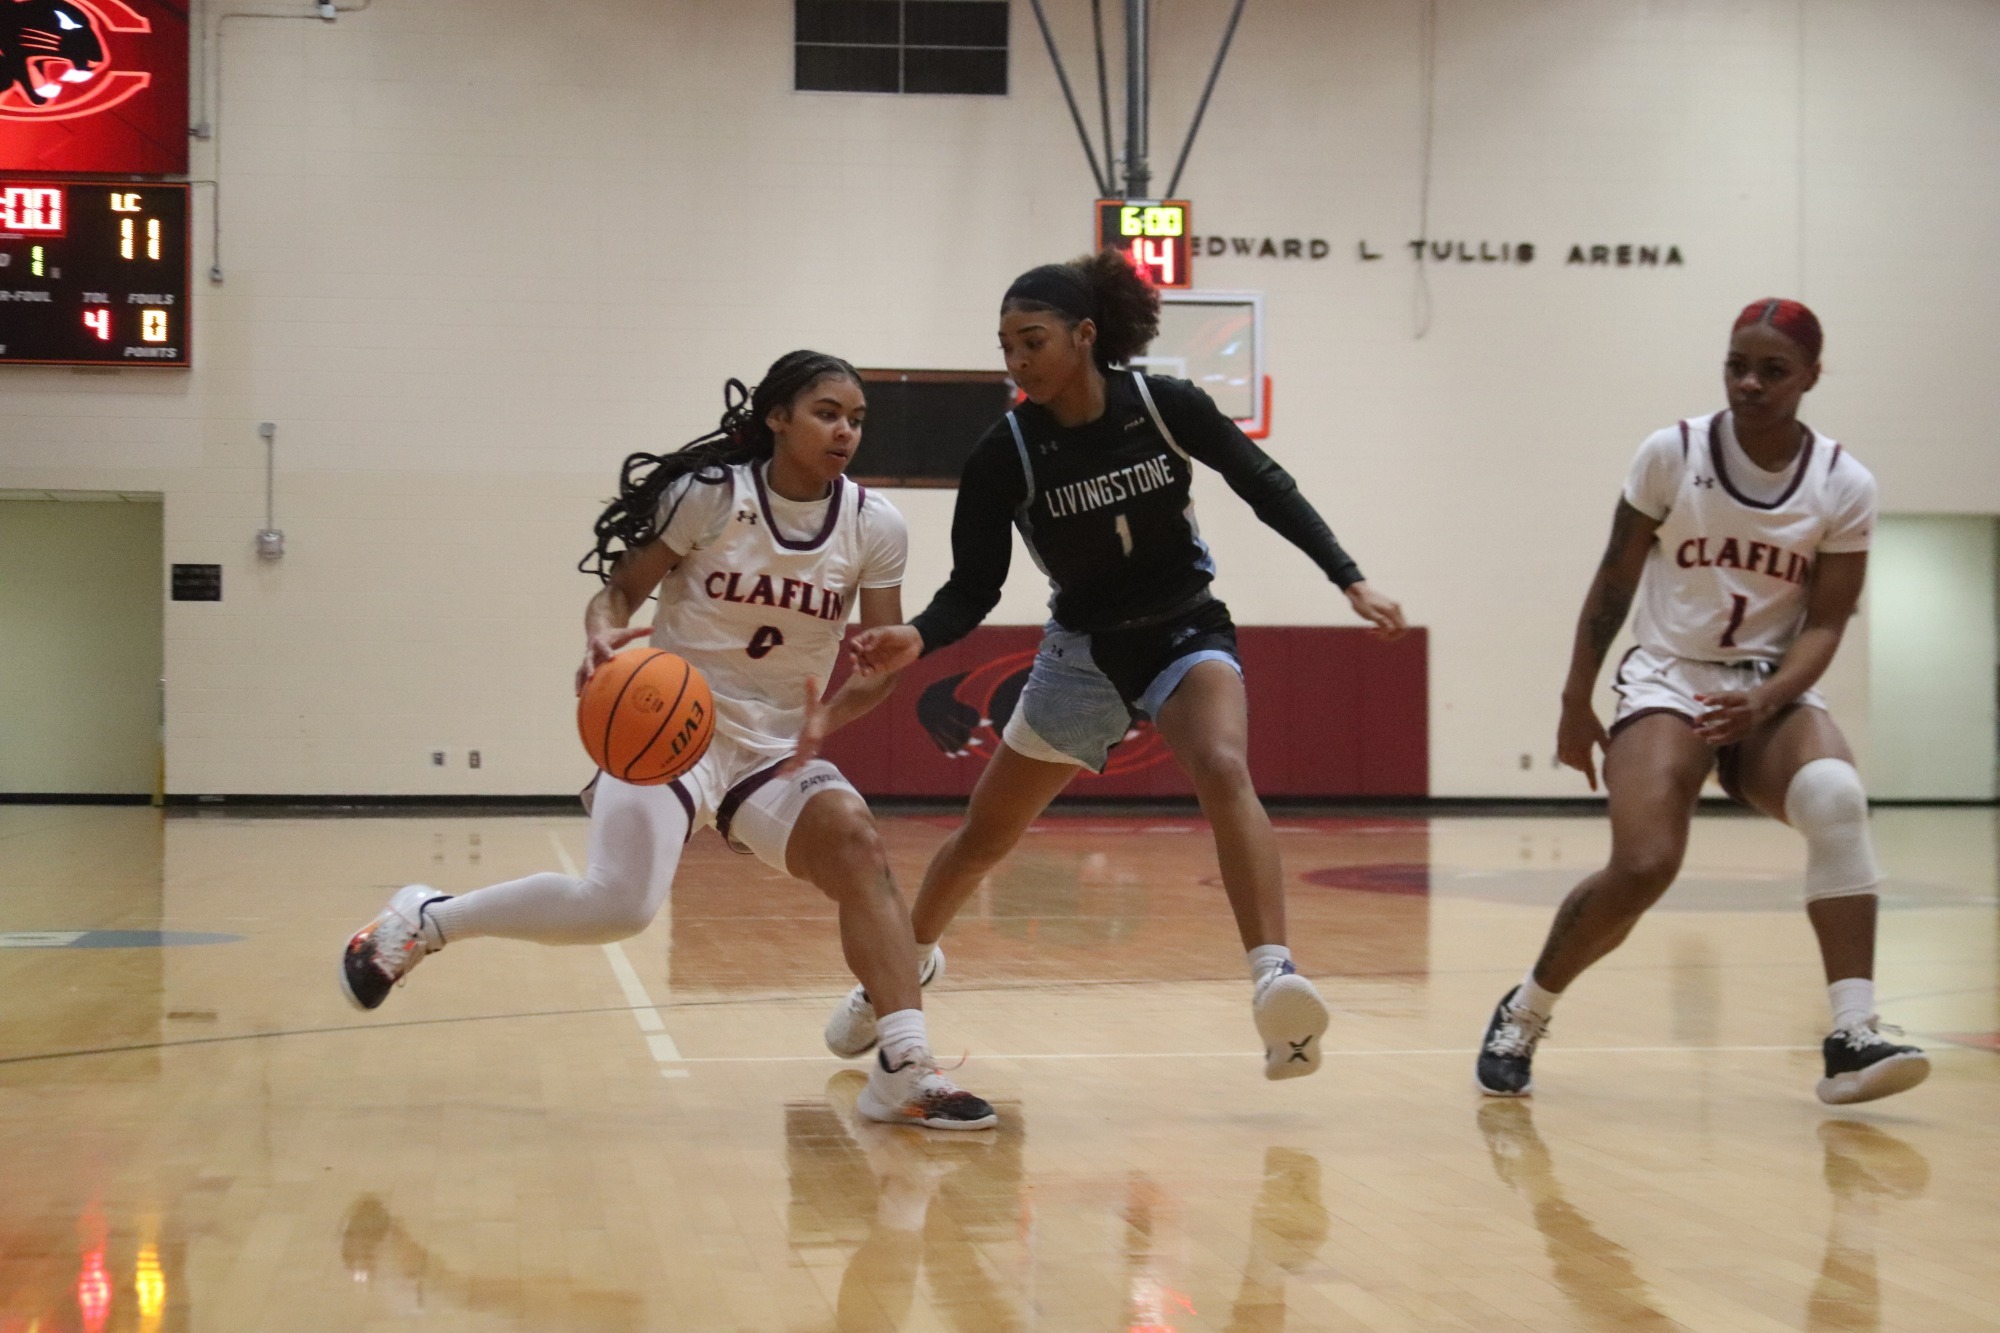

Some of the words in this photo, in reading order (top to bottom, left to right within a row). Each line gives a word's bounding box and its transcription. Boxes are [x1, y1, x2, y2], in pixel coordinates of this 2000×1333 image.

[120, 218, 160, 260] 11
[1359, 240, 1382, 261] L
[1408, 240, 1535, 264] TULLIS
[1566, 244, 1684, 266] ARENA
[31, 245, 44, 277] 1
[1131, 237, 1174, 284] 14
[127, 293, 175, 305] FOULS
[84, 309, 110, 341] 4
[142, 310, 167, 342] 0
[123, 346, 178, 359] POINTS
[1045, 453, 1175, 518] LIVINGSTONE
[1115, 513, 1134, 558] 1
[705, 570, 845, 622] CLAFLIN
[1717, 592, 1748, 648] 1
[746, 624, 784, 660] 0
